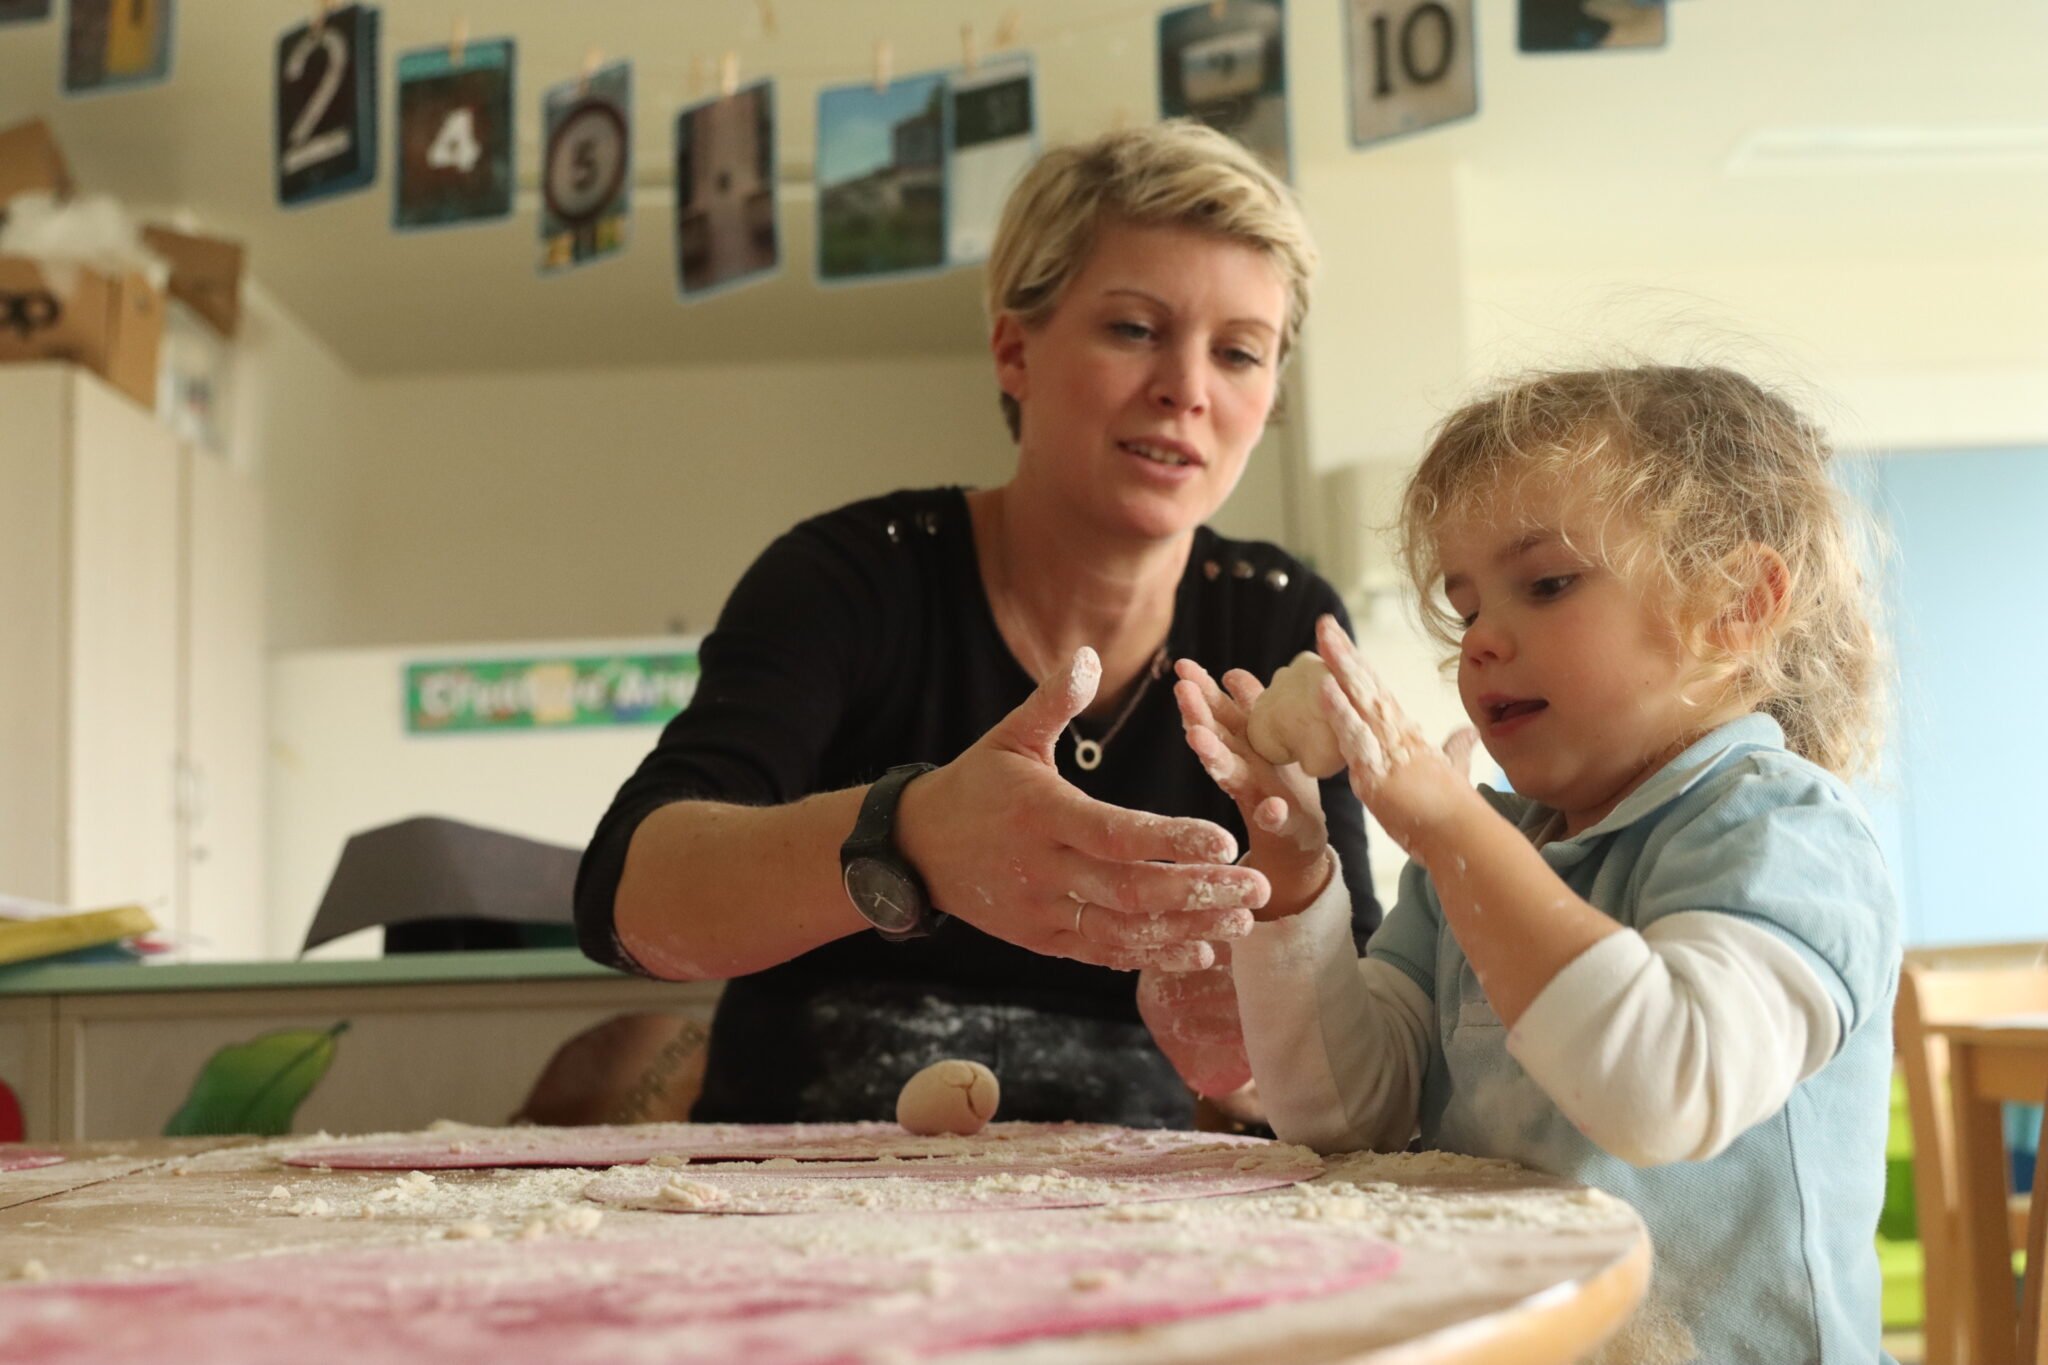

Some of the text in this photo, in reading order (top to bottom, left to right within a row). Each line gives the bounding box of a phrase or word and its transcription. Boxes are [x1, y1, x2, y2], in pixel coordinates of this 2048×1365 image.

[1372, 3, 1453, 98] 10
[285, 27, 347, 174] 2
[426, 107, 480, 173] 4
